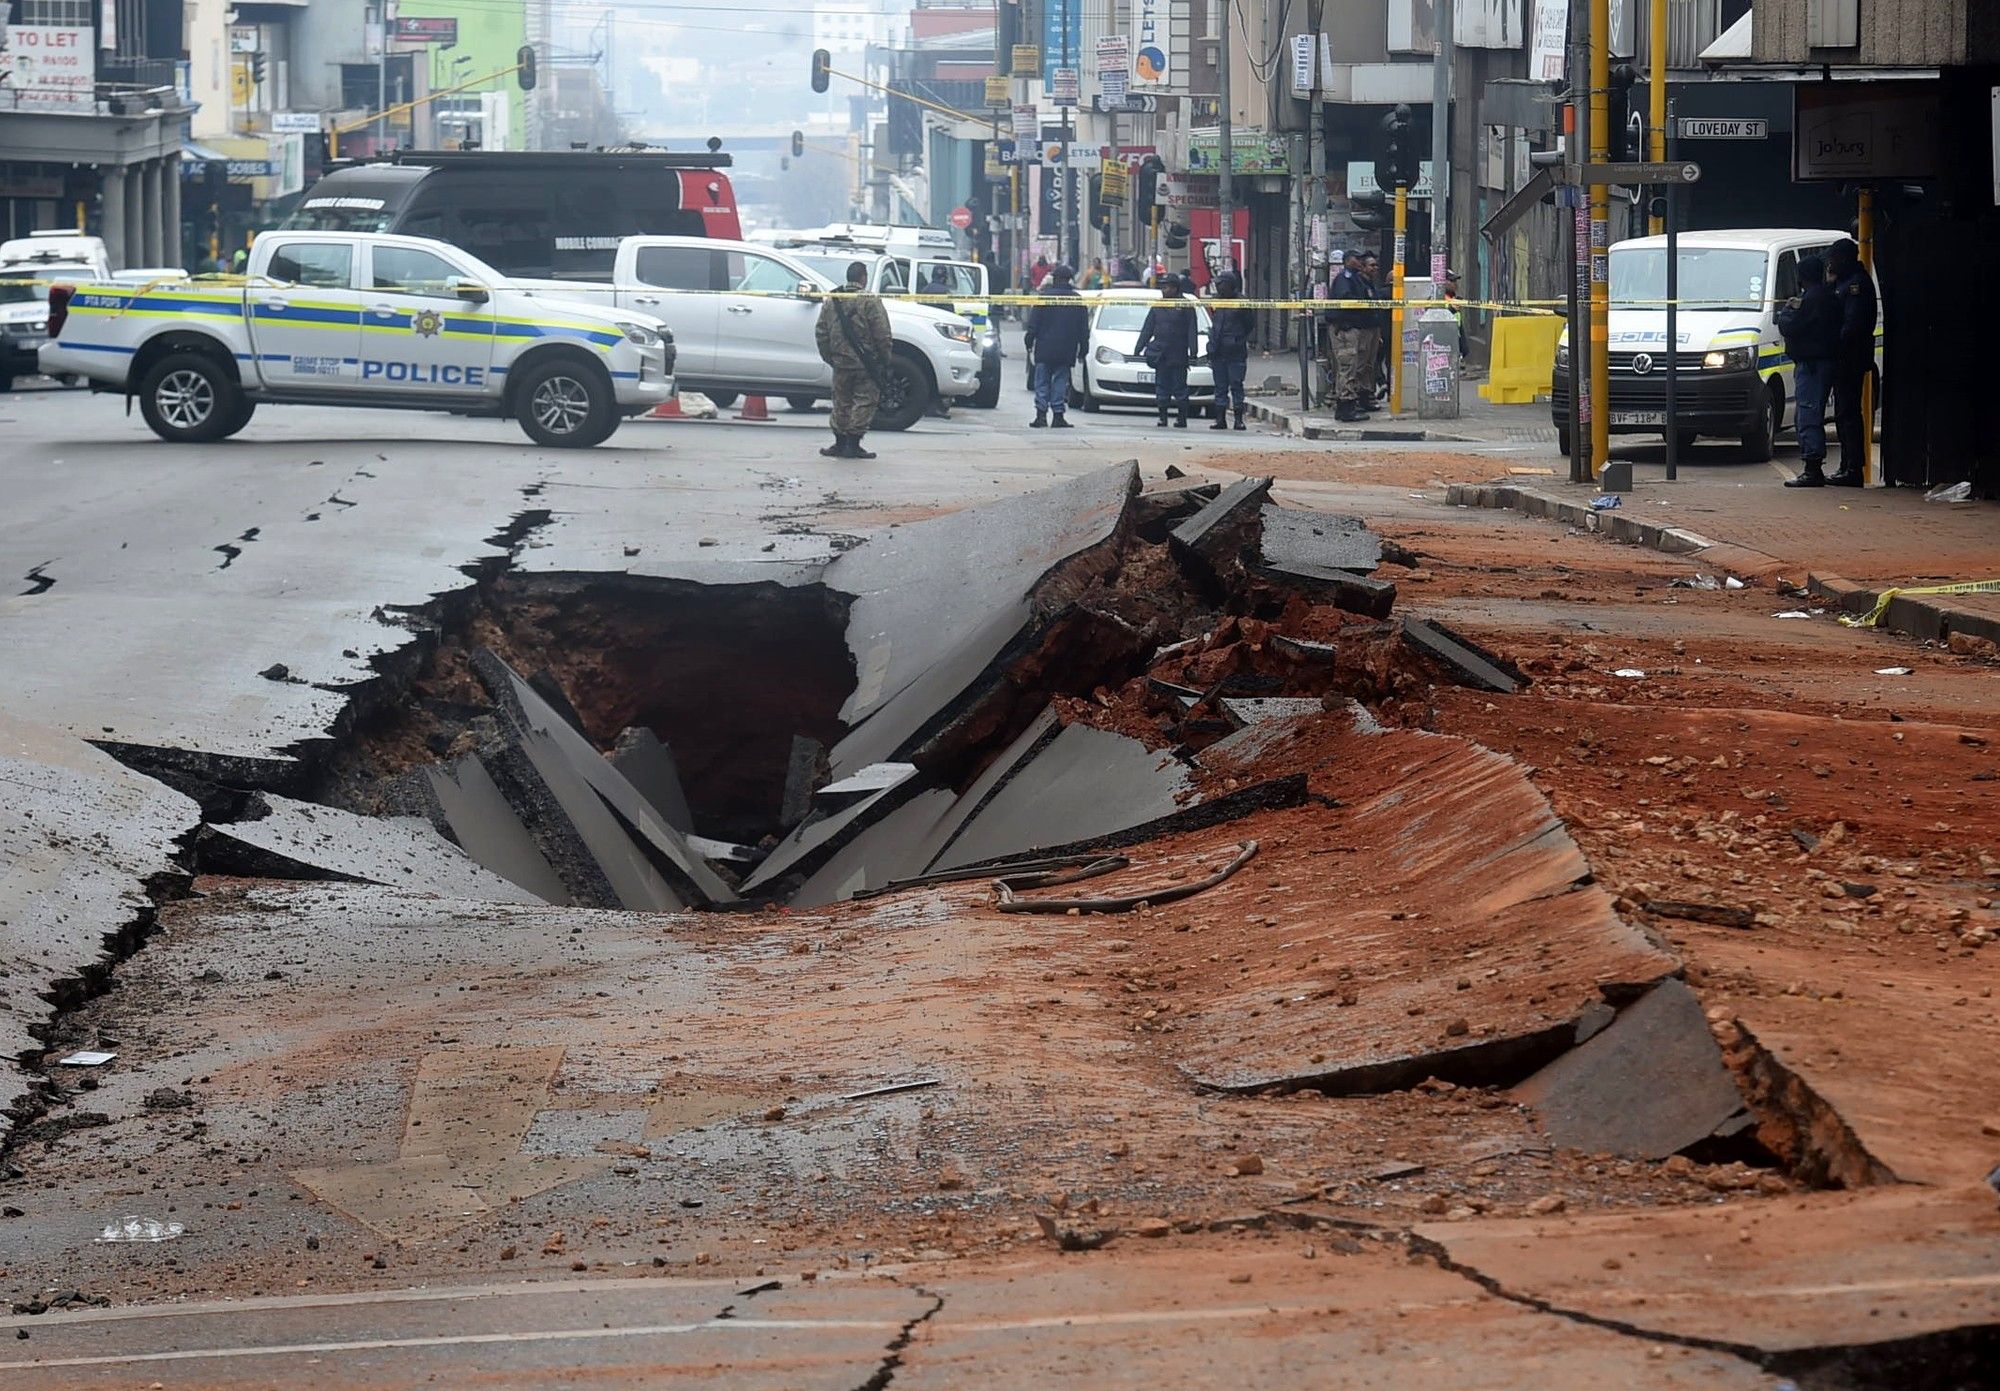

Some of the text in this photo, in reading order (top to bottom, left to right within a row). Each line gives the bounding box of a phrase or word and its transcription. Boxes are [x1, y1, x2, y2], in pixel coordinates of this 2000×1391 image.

[16, 32, 78, 47] TO LET
[1692, 123, 1760, 135] LOVEDAY ST
[362, 360, 484, 386] POLICE
